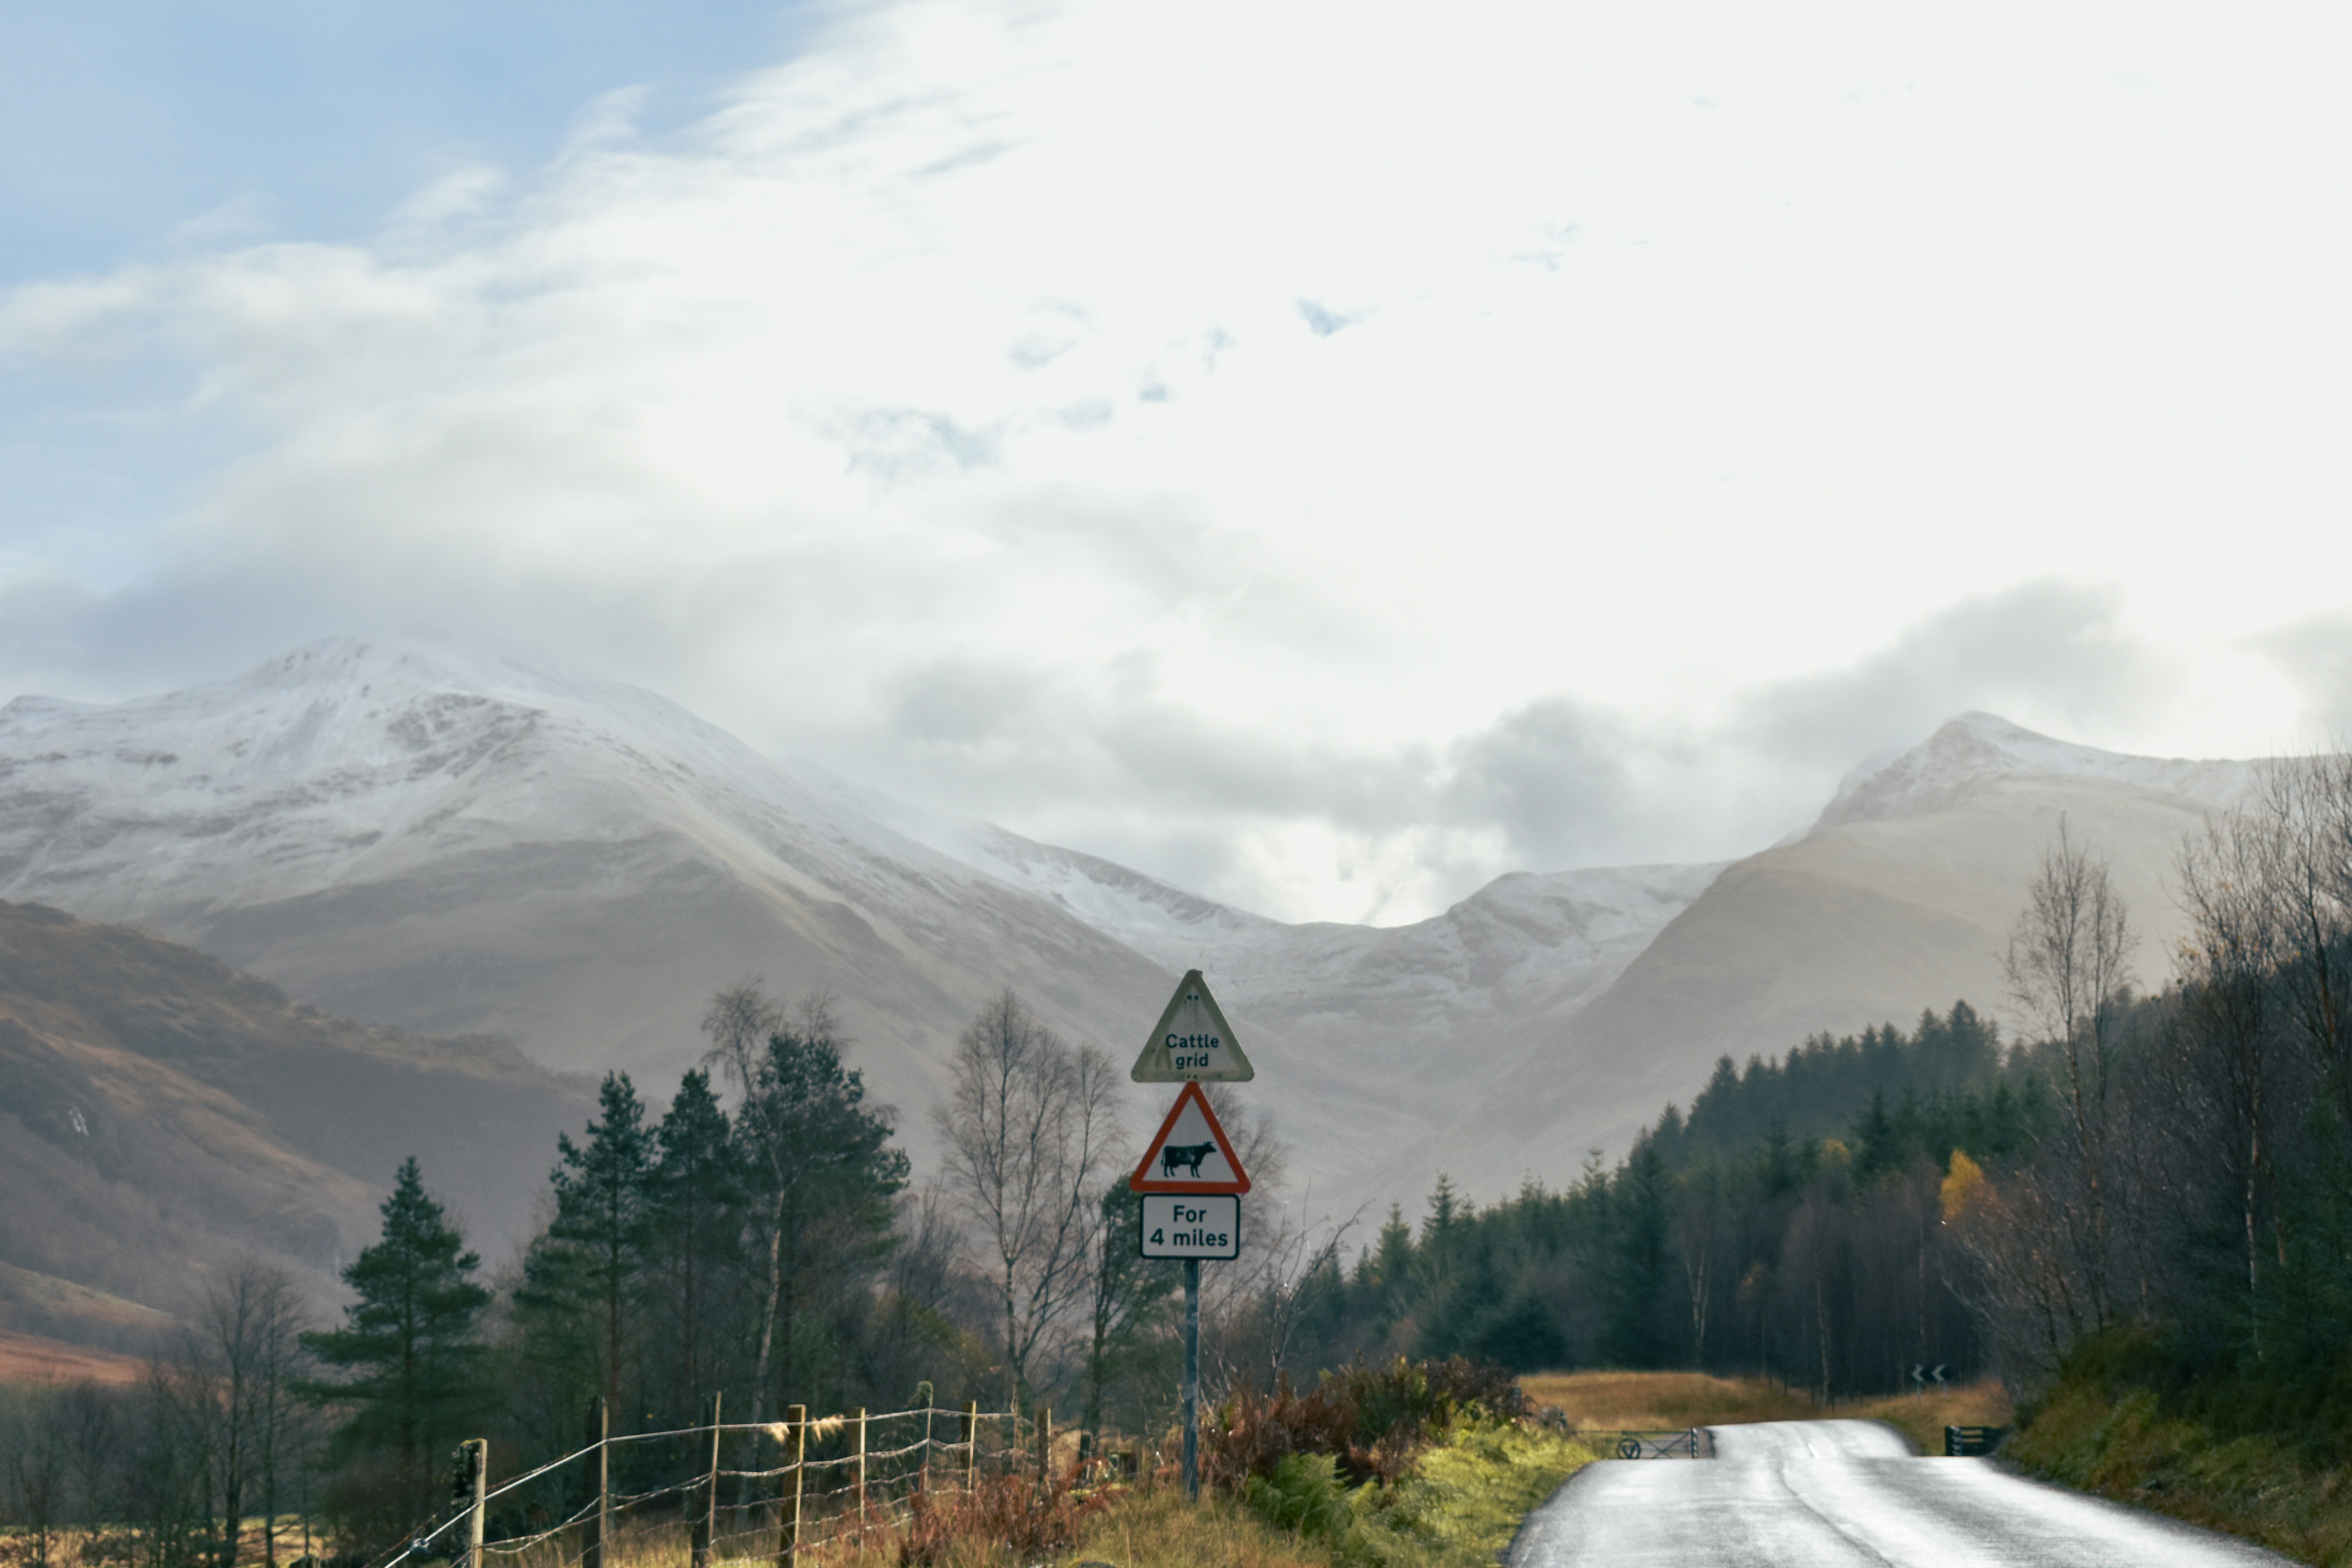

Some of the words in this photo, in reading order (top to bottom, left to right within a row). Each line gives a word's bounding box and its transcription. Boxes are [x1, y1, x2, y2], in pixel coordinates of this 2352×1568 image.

[1166, 1034, 1219, 1048] Cattle
[1176, 1052, 1209, 1069] grid
[1174, 1205, 1207, 1222] For
[1150, 1228, 1164, 1245] 4
[1174, 1228, 1228, 1246] miles
